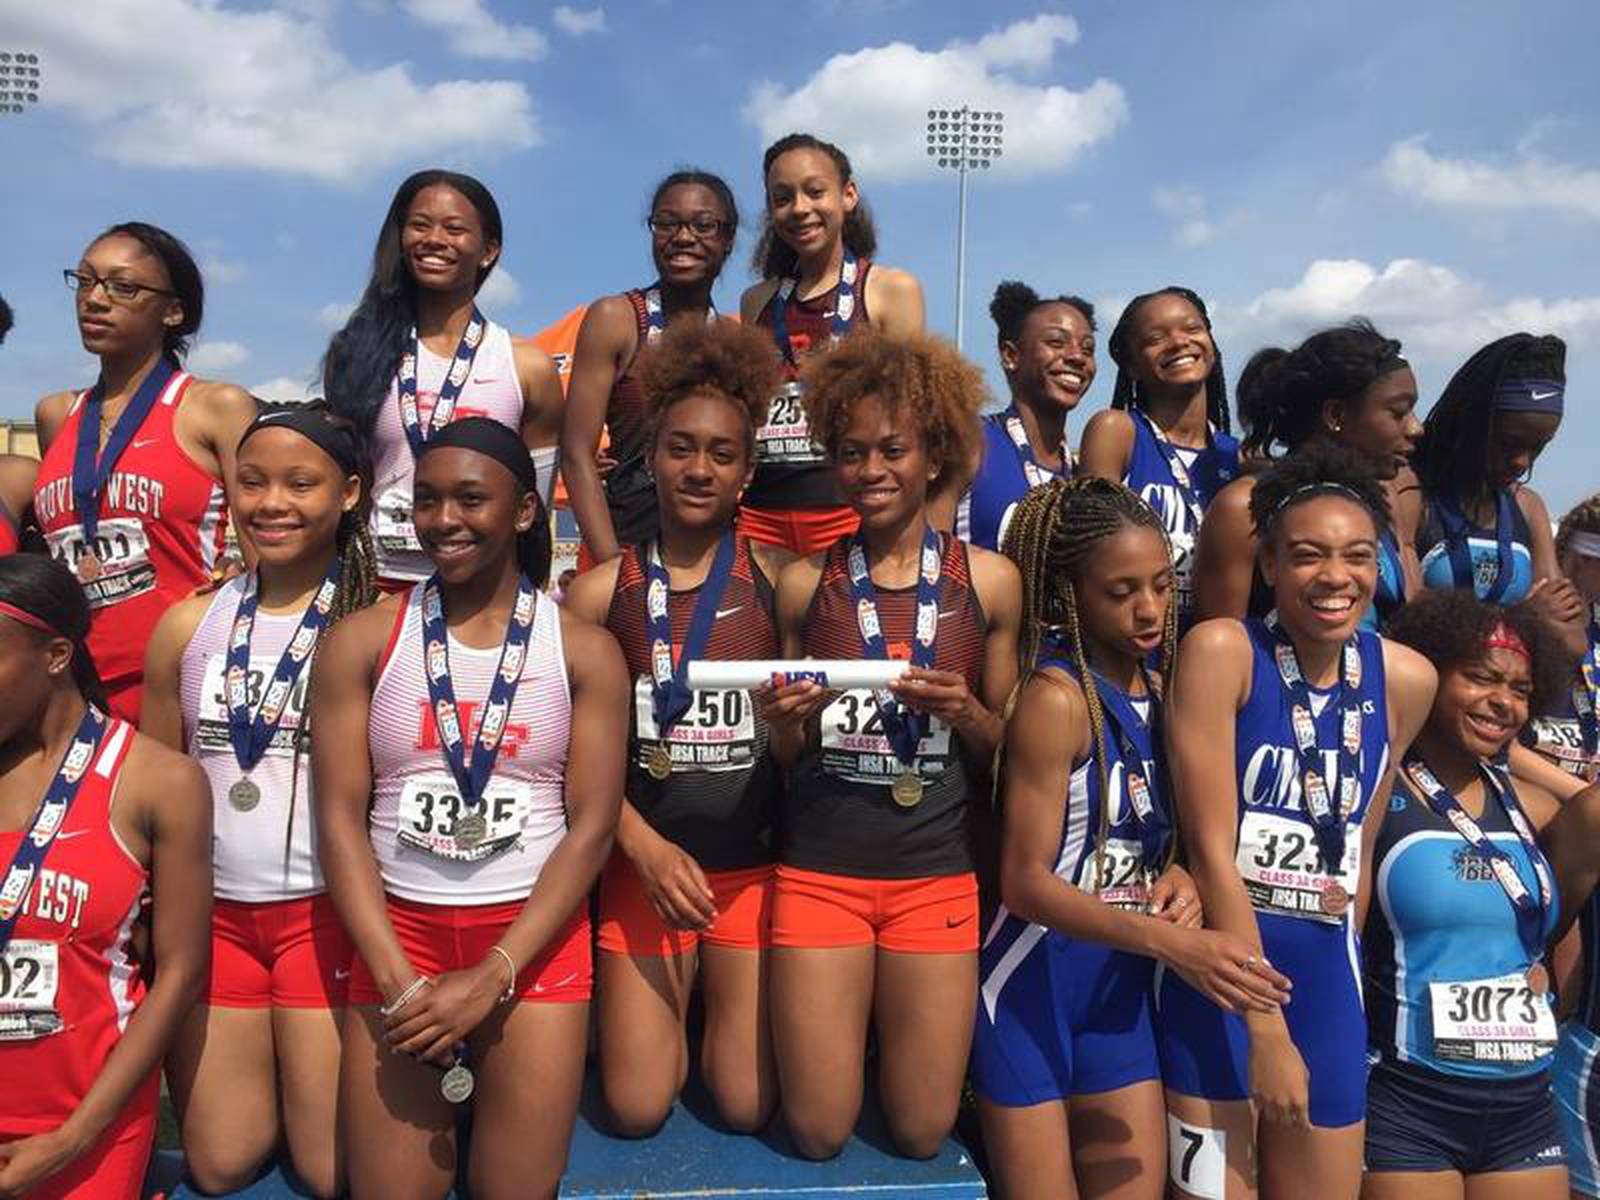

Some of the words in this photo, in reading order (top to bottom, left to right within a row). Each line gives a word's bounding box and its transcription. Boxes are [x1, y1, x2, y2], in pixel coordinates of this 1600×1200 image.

[107, 472, 164, 519] WEST
[696, 744, 730, 763] TRACK
[1259, 870, 1294, 884] CLASS
[22, 868, 90, 928] EST
[1299, 890, 1322, 913] TRA
[1448, 984, 1538, 1024] 3073
[1501, 1041, 1536, 1061] TRACK
[1180, 1128, 1203, 1183] 7
